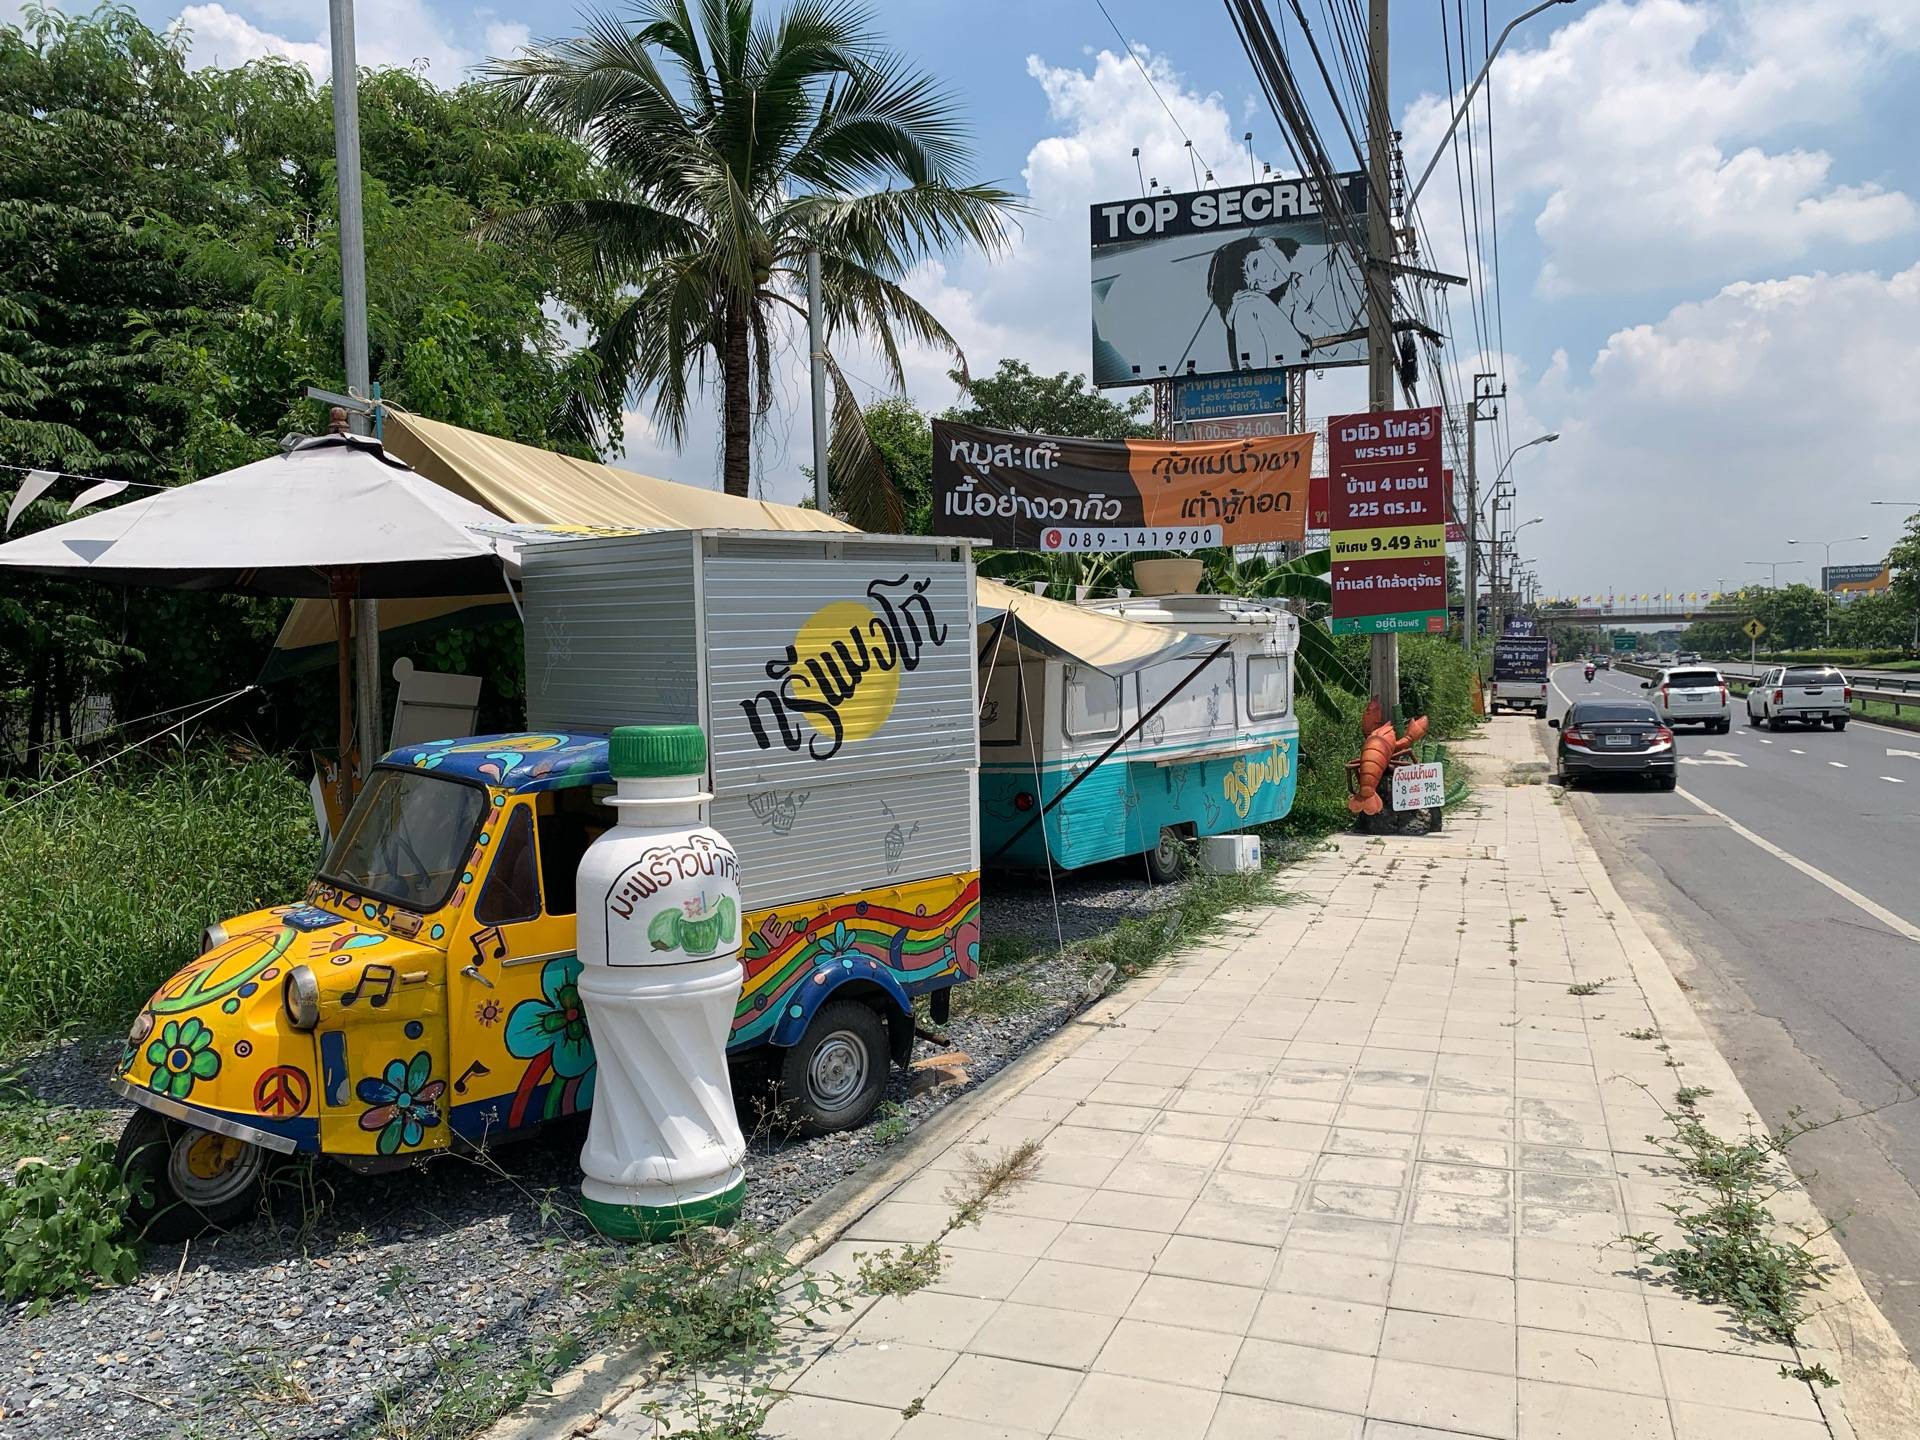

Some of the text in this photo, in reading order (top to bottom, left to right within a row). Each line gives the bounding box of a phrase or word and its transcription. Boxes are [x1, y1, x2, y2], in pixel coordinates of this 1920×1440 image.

[1101, 199, 1179, 238] TOP
[1341, 416, 1431, 442] เวนิว โฟลว์
[950, 439, 1062, 475] หมูสะเต๊ะ
[1355, 442, 1417, 459] พระราม 5
[1346, 476, 1428, 494] บ้าน 4 นอน
[1181, 488, 1292, 524] เต้าหู้ทอด
[1349, 501, 1428, 517] 225 ตร.ม.
[1068, 529, 1212, 548] 089-1419900
[1335, 542, 1368, 554] พิเศษ
[1370, 535, 1411, 552] 9.49
[1336, 573, 1442, 592] ทำเลดี ใกล้จตุจักร
[1511, 621, 1533, 629] 18-19
[1401, 785, 1407, 795] 8
[1400, 798, 1407, 808] 4
